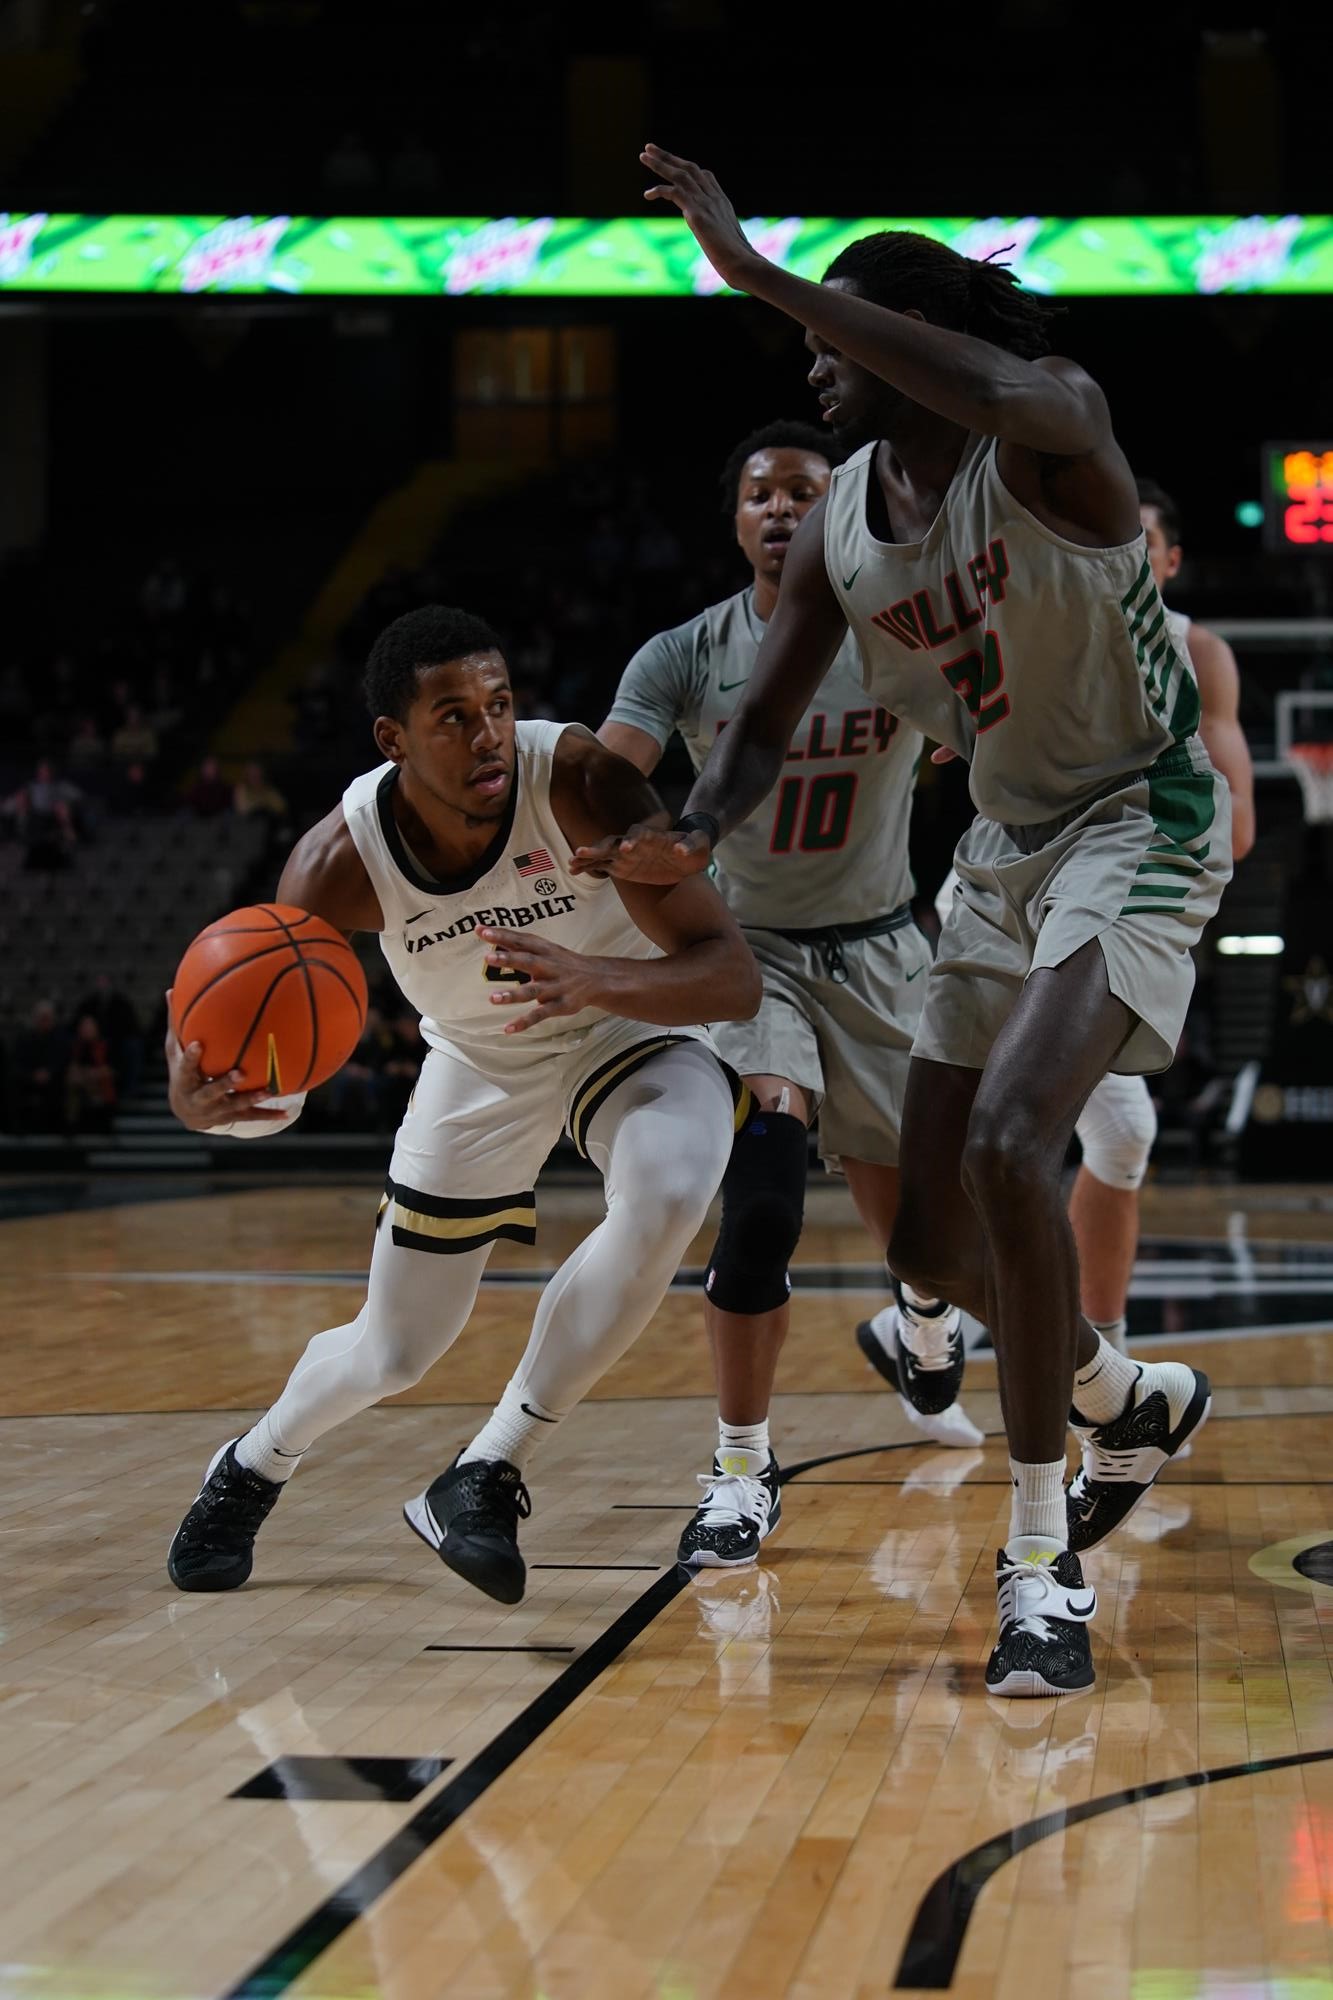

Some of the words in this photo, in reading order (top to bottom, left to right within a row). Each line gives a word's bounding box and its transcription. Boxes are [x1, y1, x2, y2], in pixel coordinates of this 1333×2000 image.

[940, 629, 1011, 735] 2
[769, 771, 859, 855] 10
[535, 878, 557, 896] SEC
[403, 894, 577, 954] VANDERBILT
